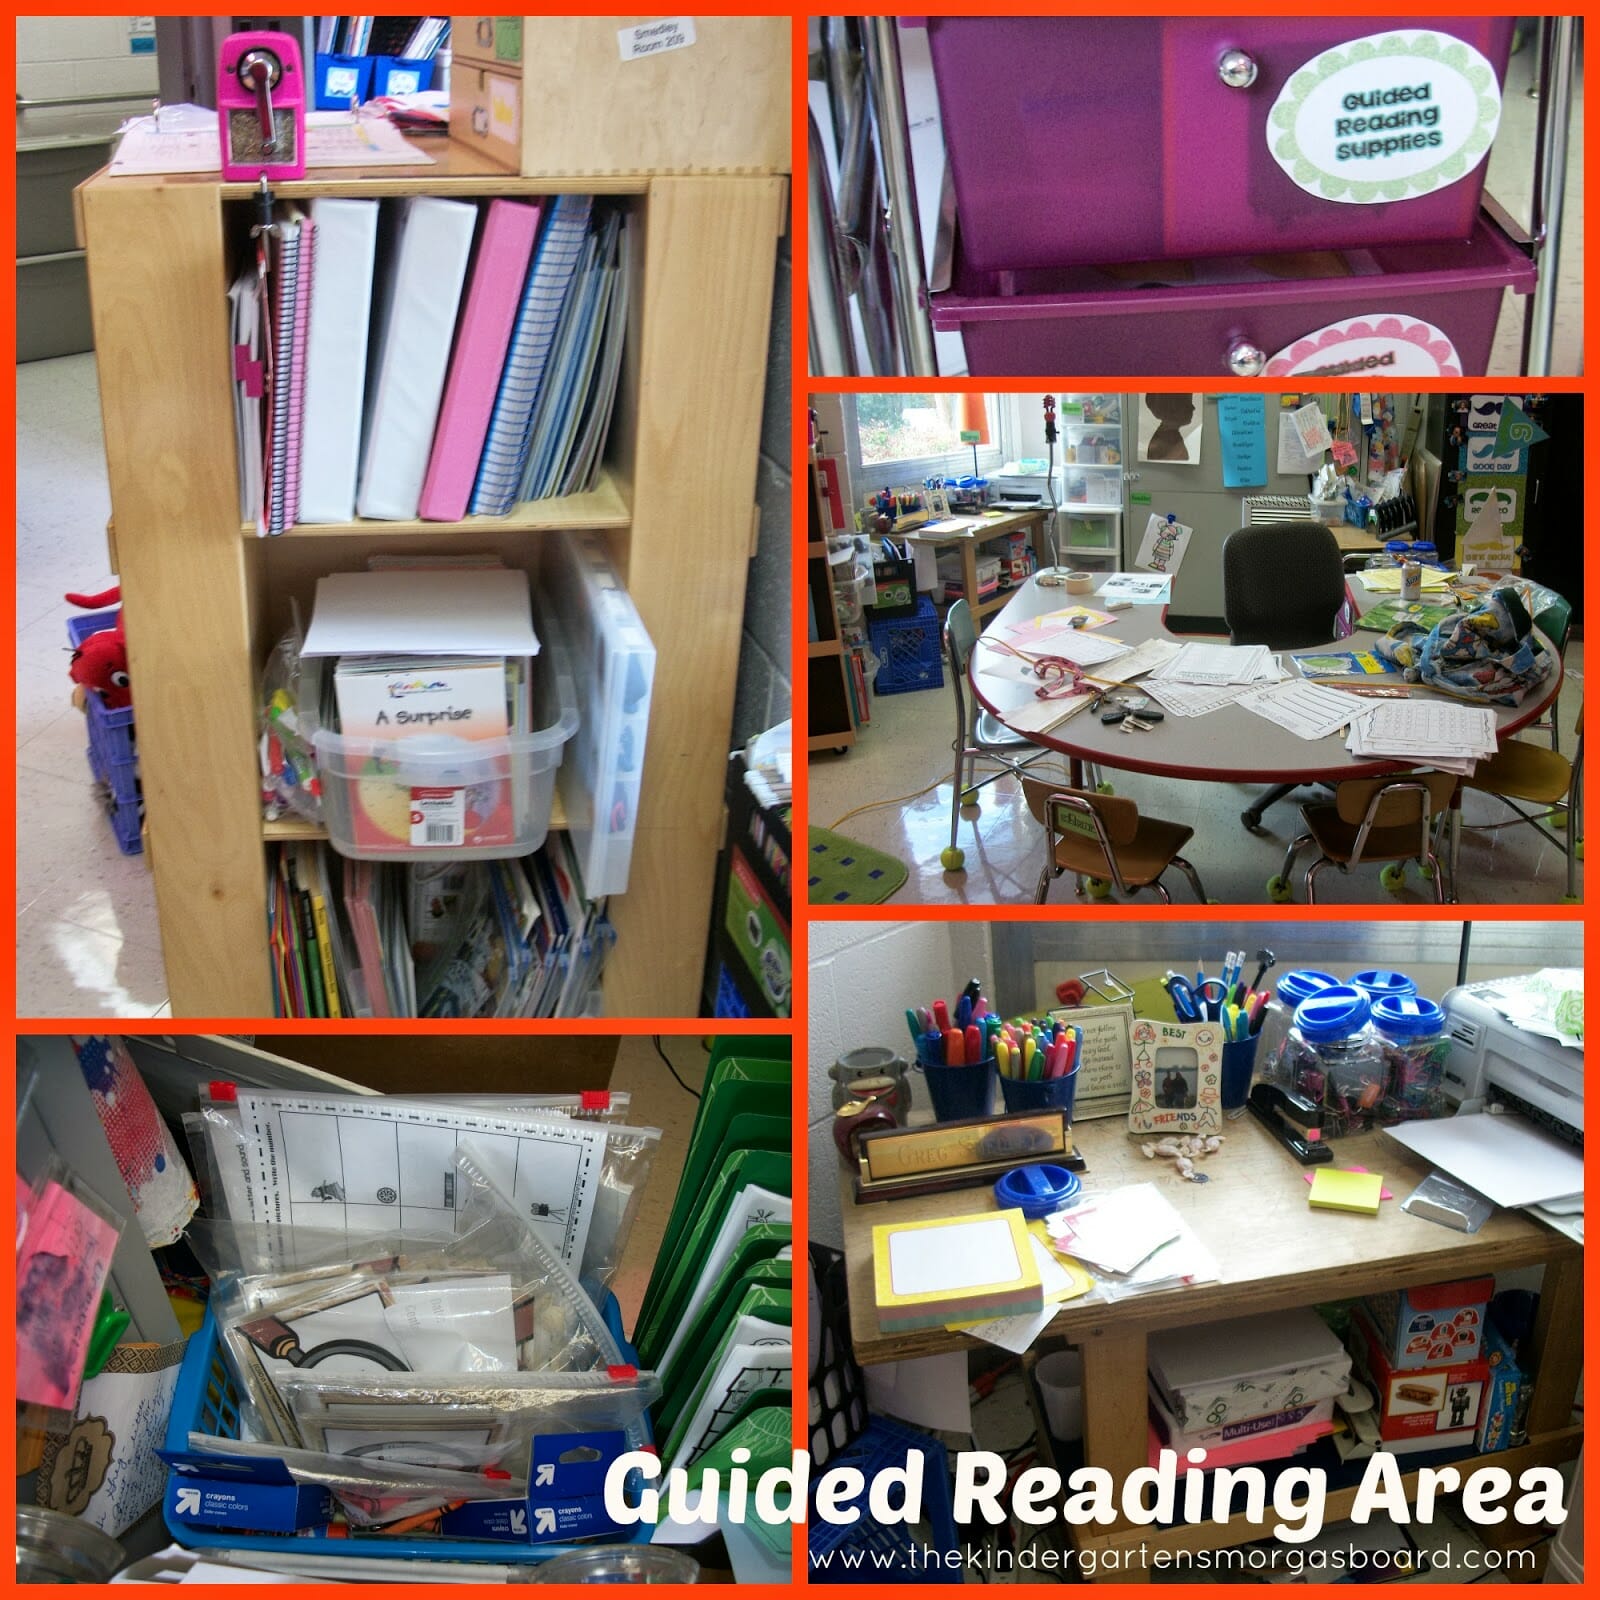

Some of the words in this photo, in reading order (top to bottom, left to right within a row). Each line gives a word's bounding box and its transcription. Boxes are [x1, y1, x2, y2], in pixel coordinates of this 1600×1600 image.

[1342, 83, 1431, 111] Guided
[1335, 105, 1441, 137] Reading
[1335, 130, 1442, 161] Supplies
[375, 711, 390, 726] A
[396, 705, 474, 726] Surprise
[1162, 1027, 1187, 1039] BEST
[1152, 1112, 1198, 1125] FRIENDS
[205, 1492, 236, 1502] crayons
[557, 1506, 583, 1516] crayons
